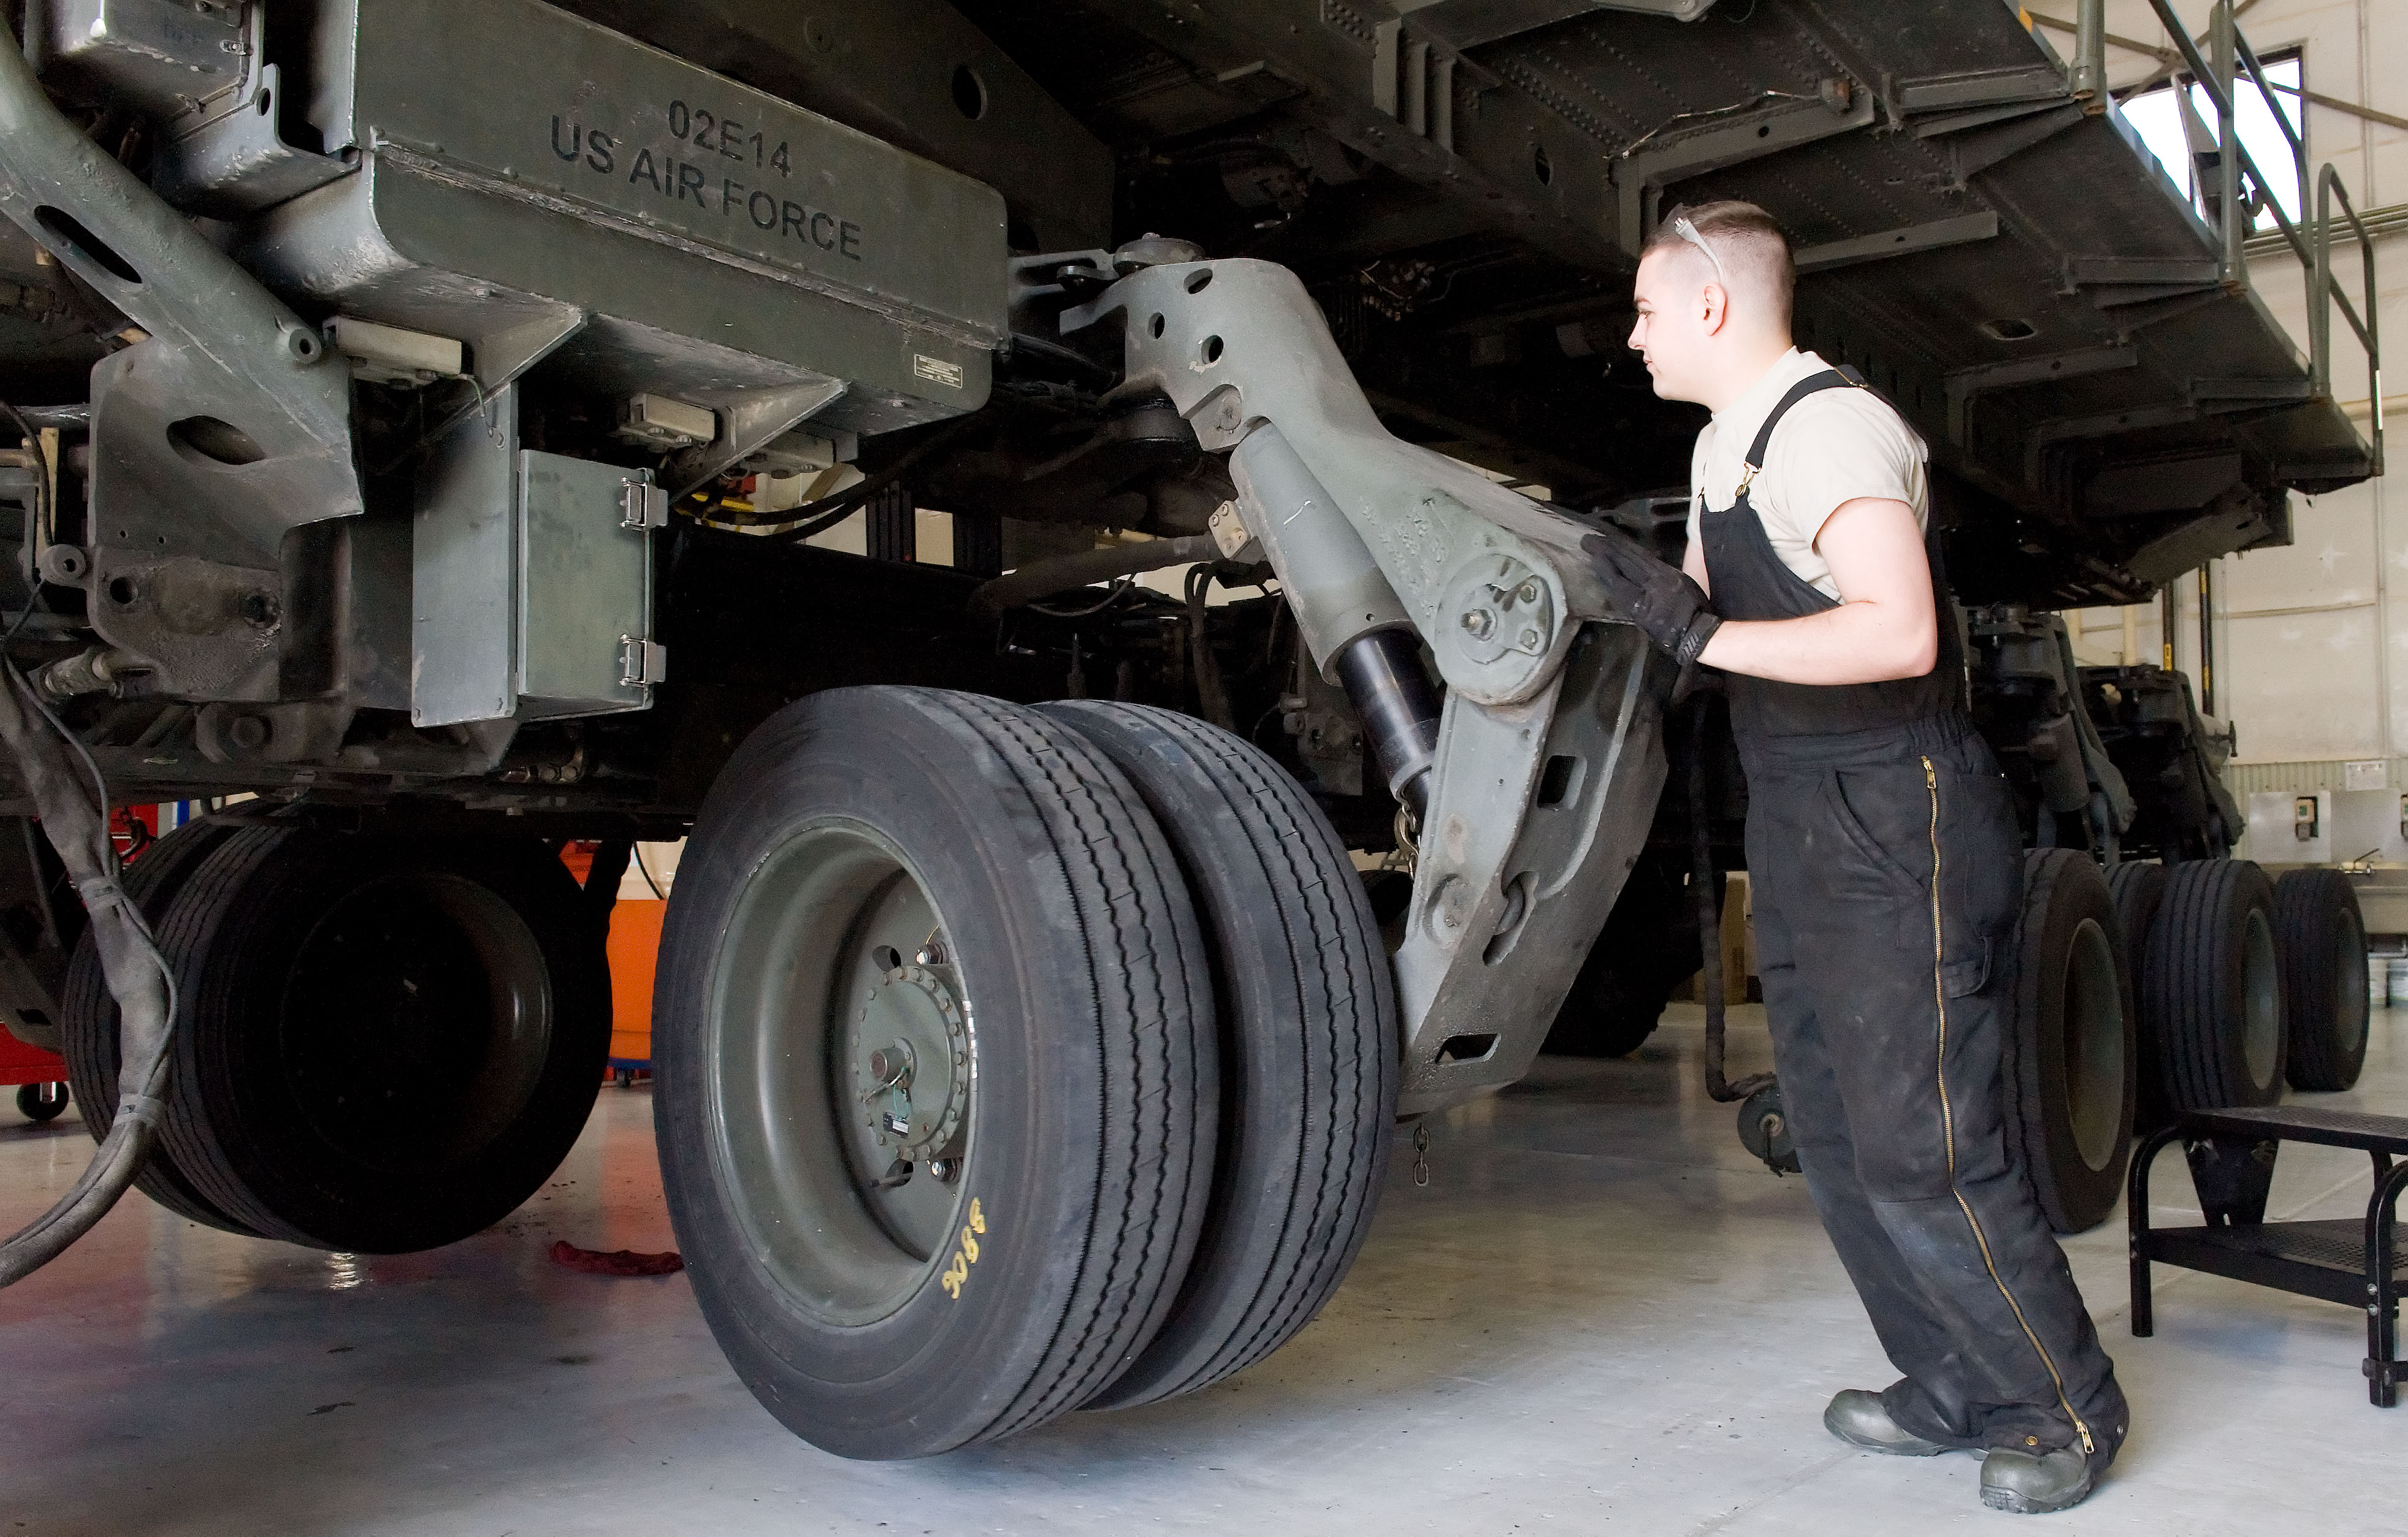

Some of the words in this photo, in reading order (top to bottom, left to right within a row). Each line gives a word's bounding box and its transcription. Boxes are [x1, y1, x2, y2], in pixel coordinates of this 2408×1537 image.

[551, 114, 614, 174] US
[629, 148, 706, 208] AIR
[722, 178, 862, 262] FORCE
[669, 99, 792, 178] 02E14
